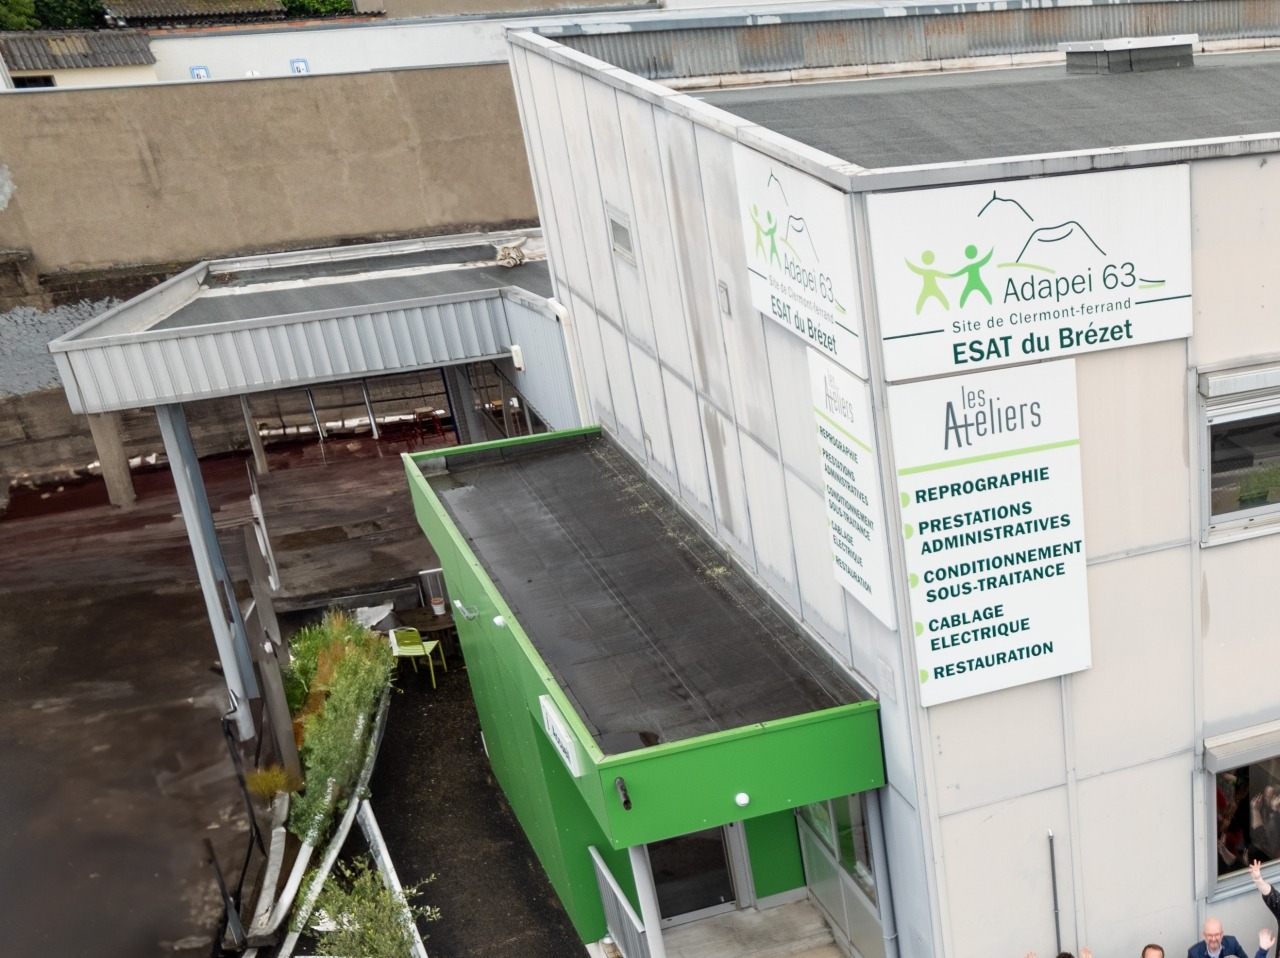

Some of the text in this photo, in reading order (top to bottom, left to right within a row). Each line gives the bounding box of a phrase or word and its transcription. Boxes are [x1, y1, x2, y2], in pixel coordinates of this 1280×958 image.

[784, 253, 834, 303] Adapei 63
[1003, 262, 1137, 304] Adapei 63
[771, 294, 837, 355] ESAT du Brézet
[952, 298, 1131, 333] Site de Clermont-ferrand
[953, 319, 1133, 365] ESAT du Brézet
[961, 385, 986, 410] les
[944, 397, 1042, 450] Ateliers
[915, 466, 1050, 504] REPROGRAPHIE
[918, 501, 1033, 535] PRESTATIONS
[921, 513, 1071, 555] ADMINISTRATIVES
[923, 540, 1082, 584] CONDITIONNEMENT
[926, 562, 1066, 603] SOUS-TRAITANCE
[928, 604, 1004, 632] CABLAGE
[930, 618, 1031, 651] ELECTRIQUE
[933, 641, 1054, 680] RESTAURATION
